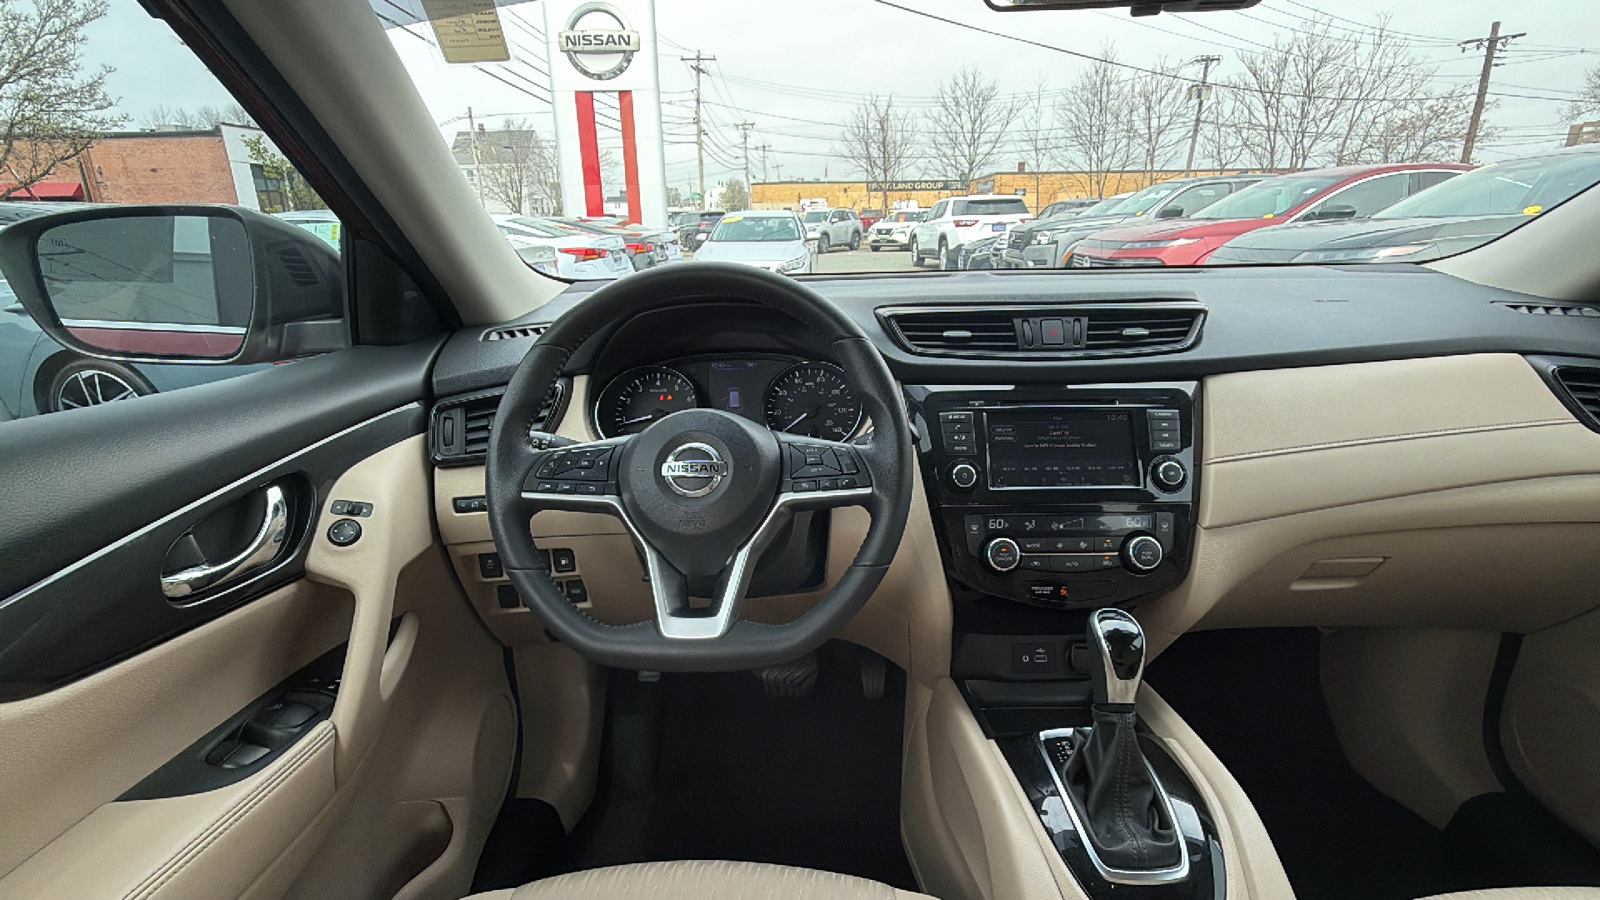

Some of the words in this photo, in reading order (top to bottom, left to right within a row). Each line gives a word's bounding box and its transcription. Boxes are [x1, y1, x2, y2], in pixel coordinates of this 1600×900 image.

[565, 34, 631, 47] NISSAN
[914, 181, 944, 189] GROUP
[666, 464, 720, 473] NISSAN
